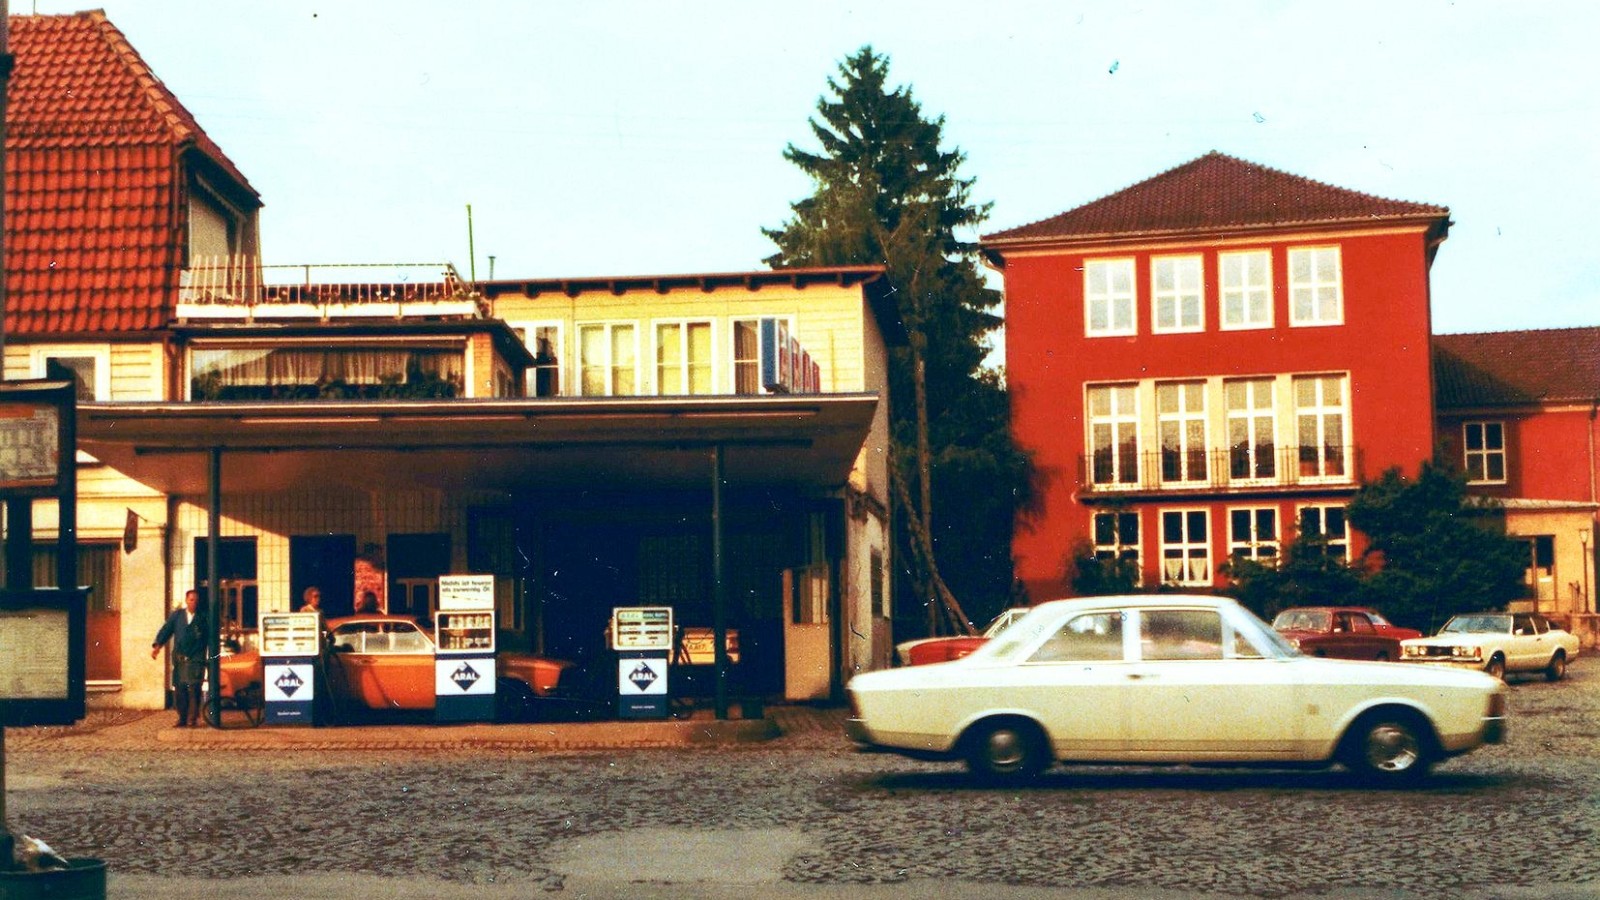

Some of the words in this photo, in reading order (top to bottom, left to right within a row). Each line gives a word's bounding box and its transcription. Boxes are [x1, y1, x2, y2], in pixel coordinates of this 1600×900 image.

[454, 672, 477, 681] ARAL
[631, 672, 655, 681] ARAL
[277, 678, 301, 687] ARAL
